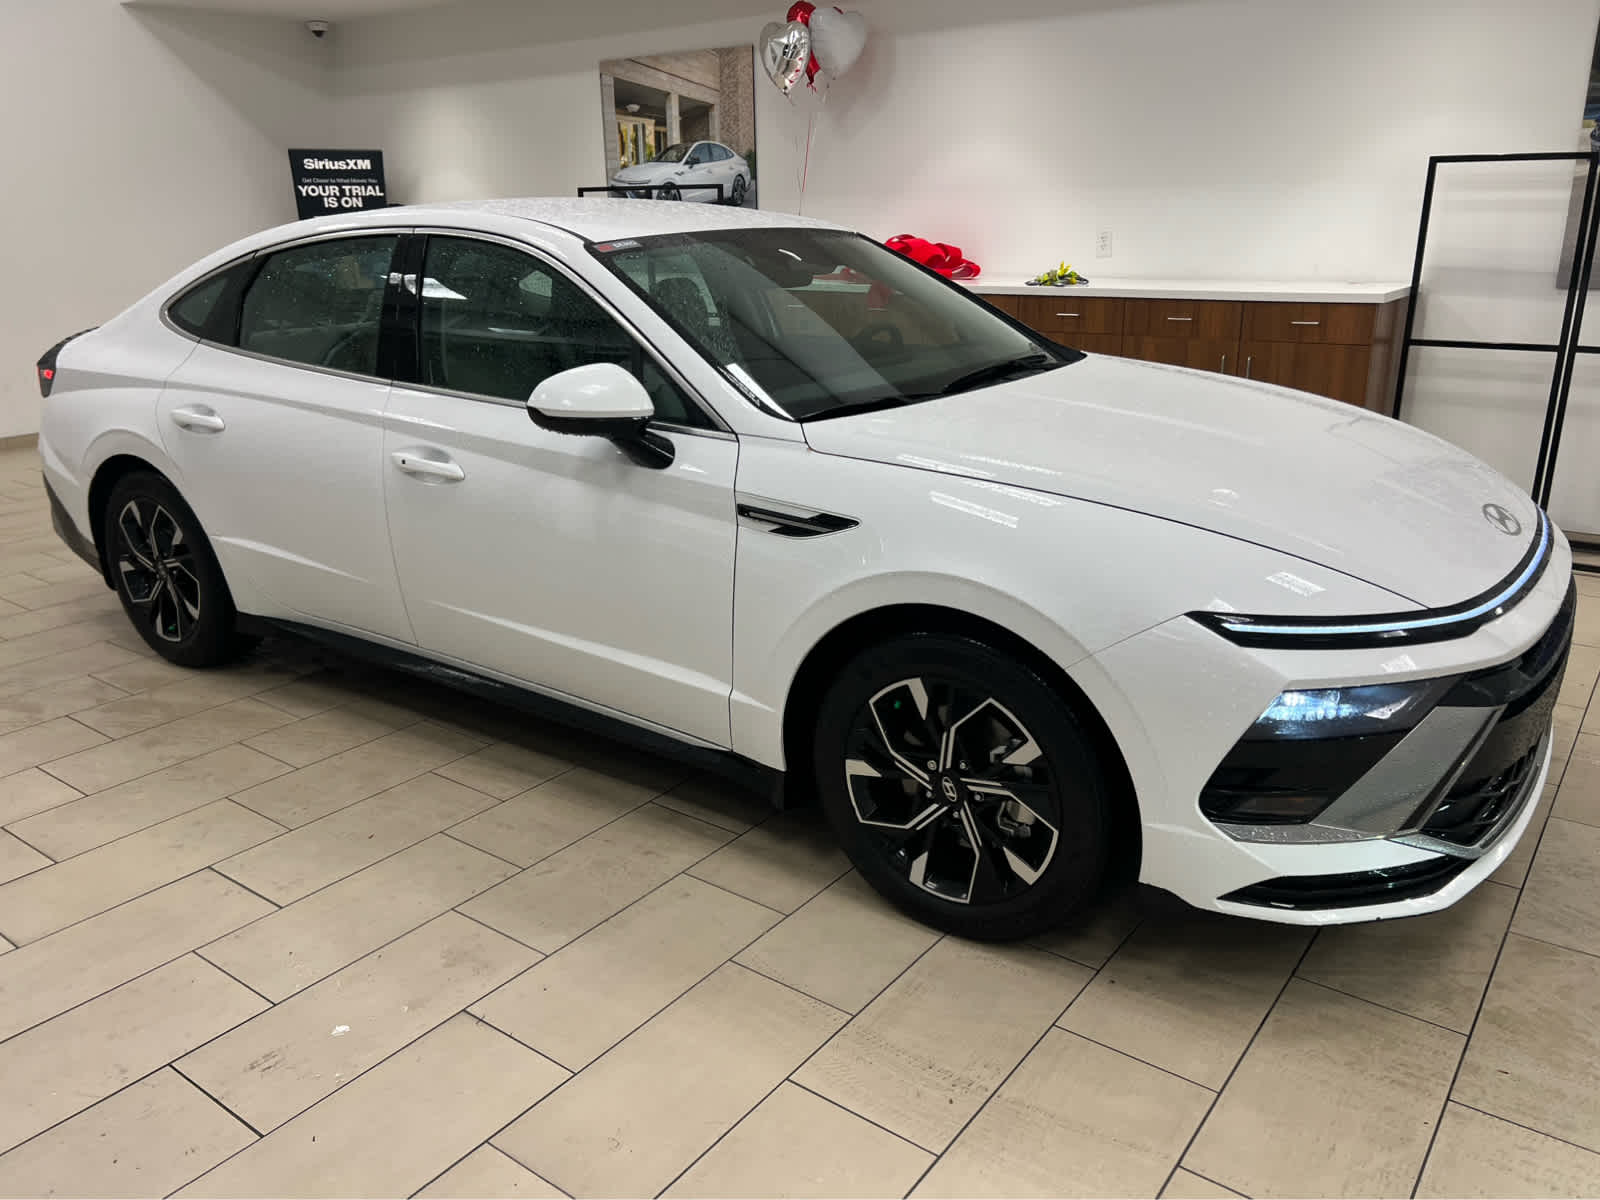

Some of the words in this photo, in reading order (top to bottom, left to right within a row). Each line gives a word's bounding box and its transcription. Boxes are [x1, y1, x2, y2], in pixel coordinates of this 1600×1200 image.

[303, 158, 371, 170] SiriusXM
[298, 185, 340, 197] YOUR
[342, 185, 384, 196] TRIAL
[324, 197, 338, 208] IS
[341, 197, 363, 208] ON
